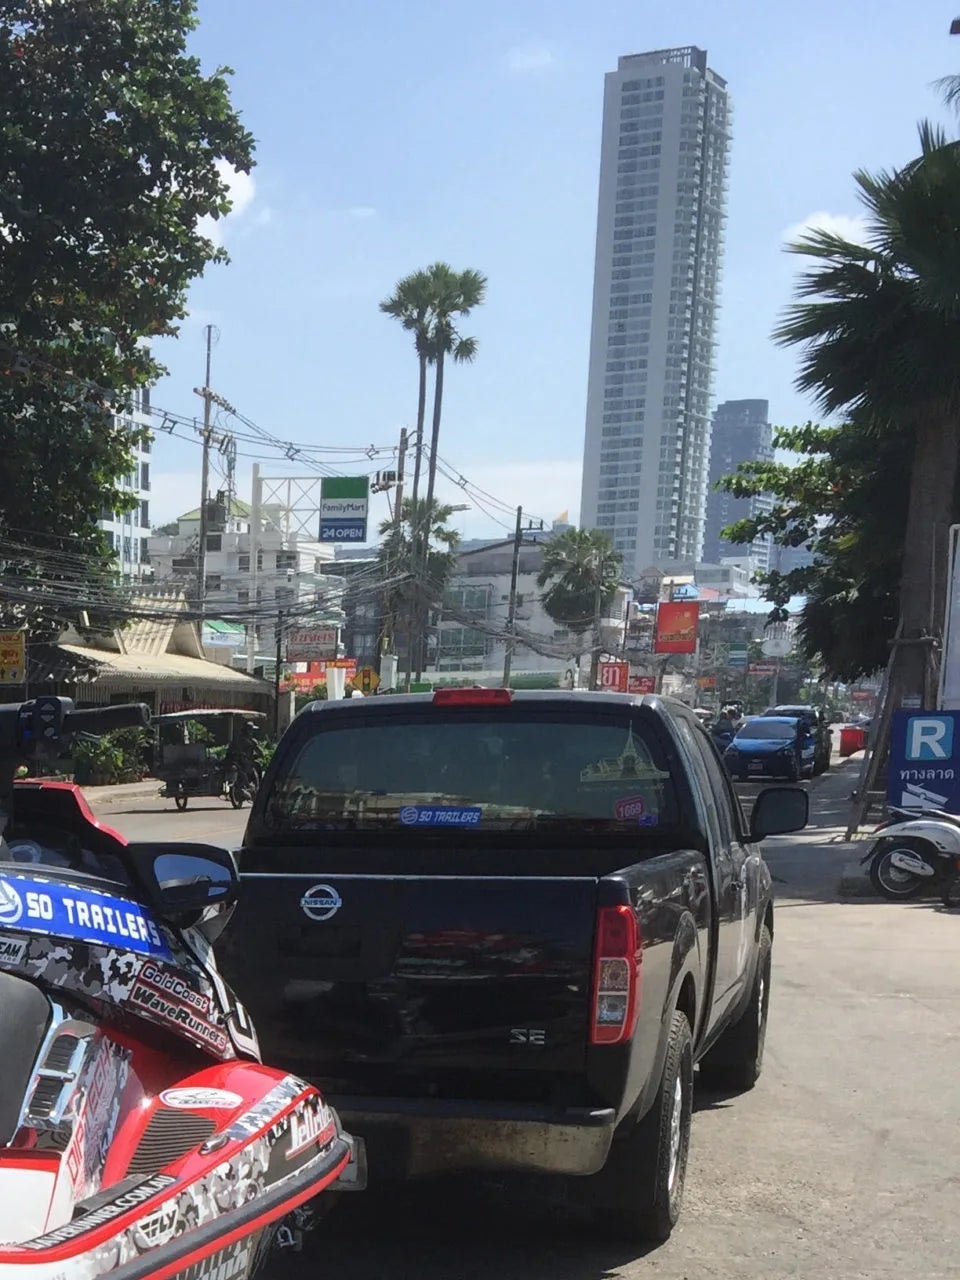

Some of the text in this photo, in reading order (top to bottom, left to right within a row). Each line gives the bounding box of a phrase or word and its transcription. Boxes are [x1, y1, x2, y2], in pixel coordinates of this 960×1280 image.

[322, 503, 365, 513] FamilyMart
[322, 528, 363, 538] 24 OPEN
[911, 720, 947, 758] R
[900, 769, 955, 780] ทางลาด
[434, 811, 481, 823] TRAILERS
[61, 897, 161, 946] TRAILERS
[142, 965, 209, 1010] GoldCoast
[132, 985, 227, 1048] WaveRunners
